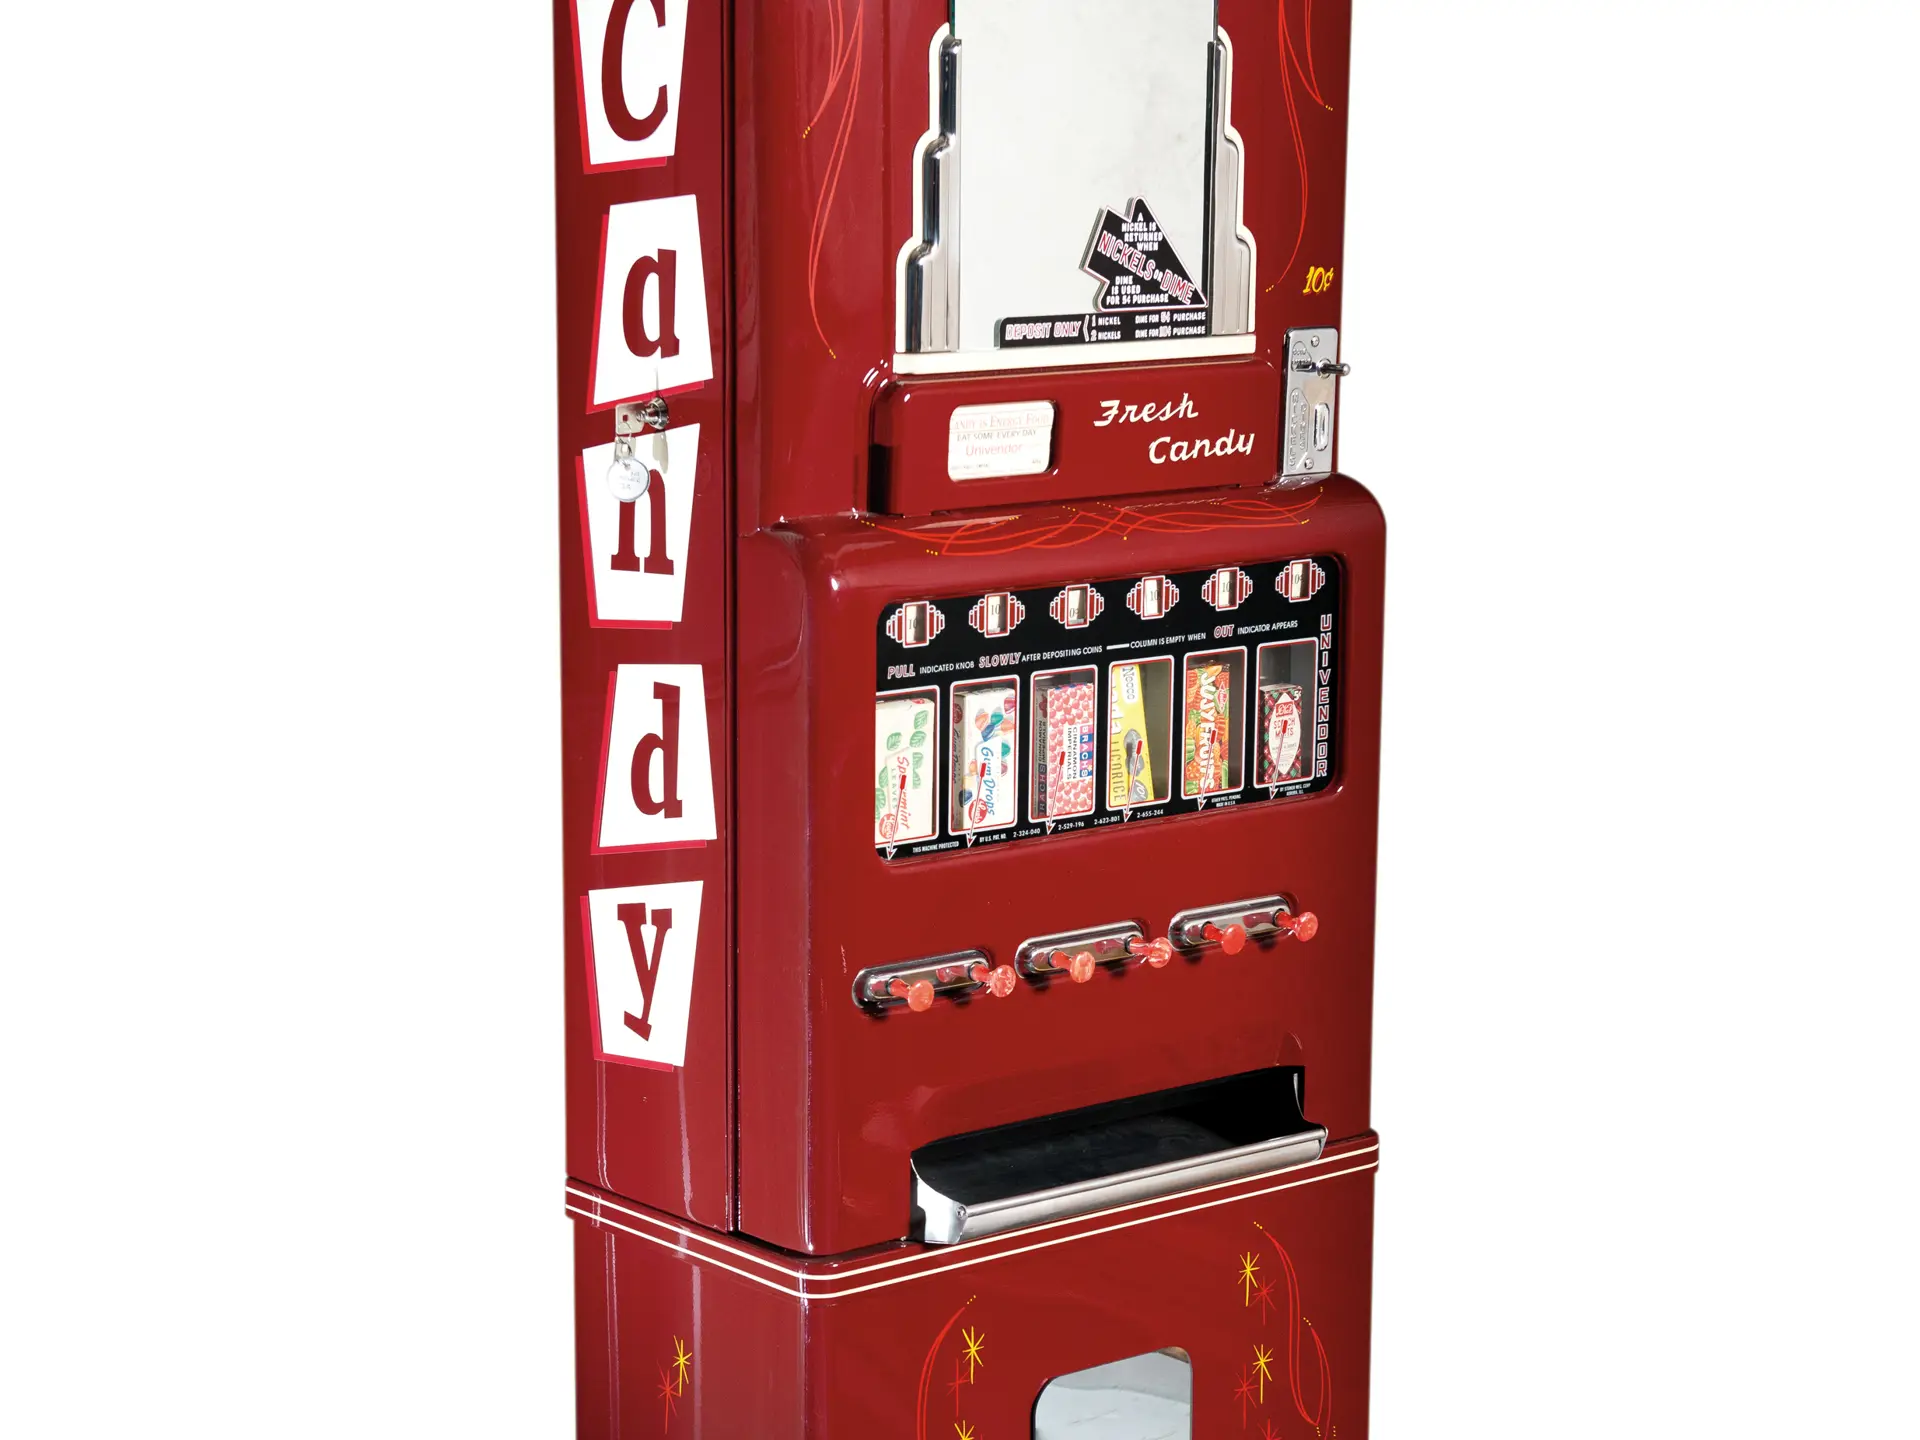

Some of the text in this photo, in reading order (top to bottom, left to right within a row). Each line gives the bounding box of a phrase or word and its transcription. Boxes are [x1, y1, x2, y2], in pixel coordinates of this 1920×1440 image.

[1136, 212, 1145, 222] A
[1121, 222, 1157, 233] NICKEL IS
[1124, 231, 1163, 242] RETURNED
[1136, 241, 1159, 251] WHEN
[1096, 230, 1155, 281] NICKELS
[1159, 269, 1195, 305] DIME
[1115, 275, 1133, 285] DIME
[1302, 265, 1334, 294] 10¢
[1111, 285, 1141, 295] IS USED
[1106, 293, 1169, 306] FOR 5¢ PURCHASE
[1098, 316, 1121, 325] NICKEL
[1135, 315, 1148, 324] DIME
[1148, 315, 1159, 323] FOR
[1172, 311, 1206, 322] PURCHASE
[1005, 321, 1082, 340] DEPOSIT ONLY
[1090, 329, 1097, 341] 2
[1098, 331, 1121, 340] NICKELS
[1135, 329, 1148, 339] DIME
[1148, 329, 1159, 338] FOR
[1172, 325, 1206, 336] PURCHASE
[1093, 392, 1199, 427] Fresh
[973, 431, 993, 441] SOME
[997, 430, 1020, 439] EVERY
[1022, 428, 1037, 437] DAY
[965, 443, 1023, 457] Univendor
[1148, 427, 1255, 464] Candy
[601, 0, 682, 1042] Candy
[887, 619, 1298, 680] PULL INDICATED KNOB SLOWLY AFTER DEPOSITING COINS COLUMN IS EMPTY WHEN OUT INDICATOR APPEARS
[1316, 613, 1333, 778] UNIVENDOR
[1273, 717, 1296, 730] SCCH
[1275, 727, 1294, 739] MTS
[890, 767, 898, 810] LEAVES
[980, 746, 997, 816] Gum Drops
[896, 756, 912, 831] Sprmint
[921, 844, 938, 853] MACHINE
[938, 841, 960, 850] PROTECTED
[1013, 828, 1041, 837] 2-324-040
[1058, 821, 1085, 831] 2-529-196
[1136, 809, 1164, 819] 2-655-244
